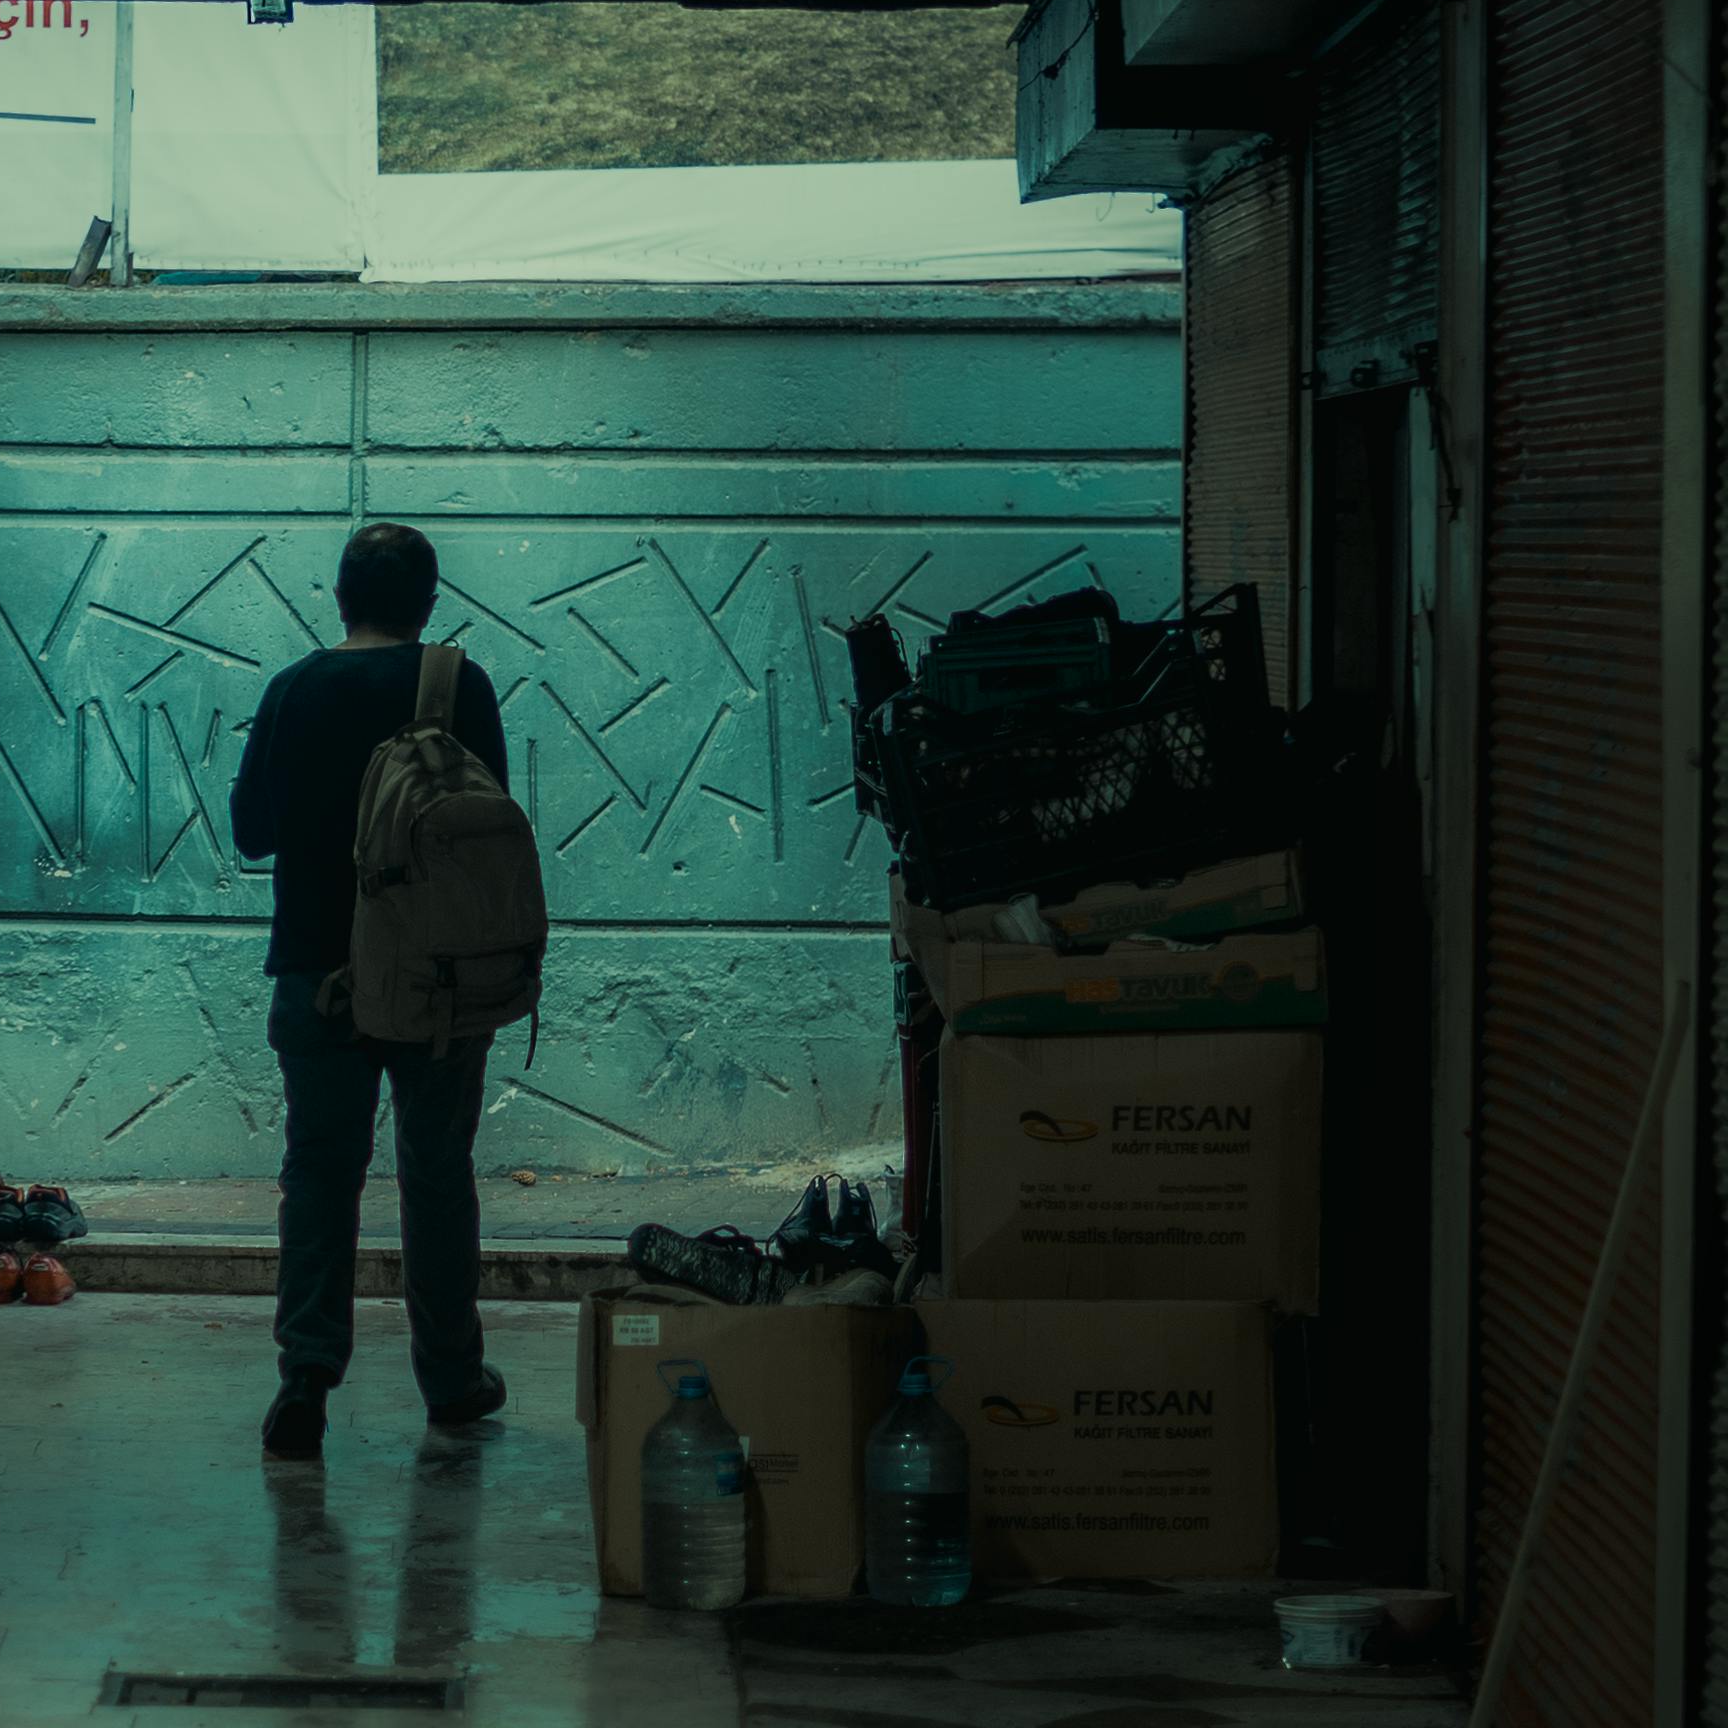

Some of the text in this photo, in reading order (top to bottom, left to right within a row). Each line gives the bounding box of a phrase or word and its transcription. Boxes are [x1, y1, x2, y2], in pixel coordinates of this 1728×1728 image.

[1112, 1105, 1251, 1132] FERSAN
[1021, 1227, 1246, 1246] www.satis.fersanfiltre.com
[1074, 1390, 1213, 1416] FERSAN
[985, 1513, 1210, 1531] www.satis.fersanfiltre.com
